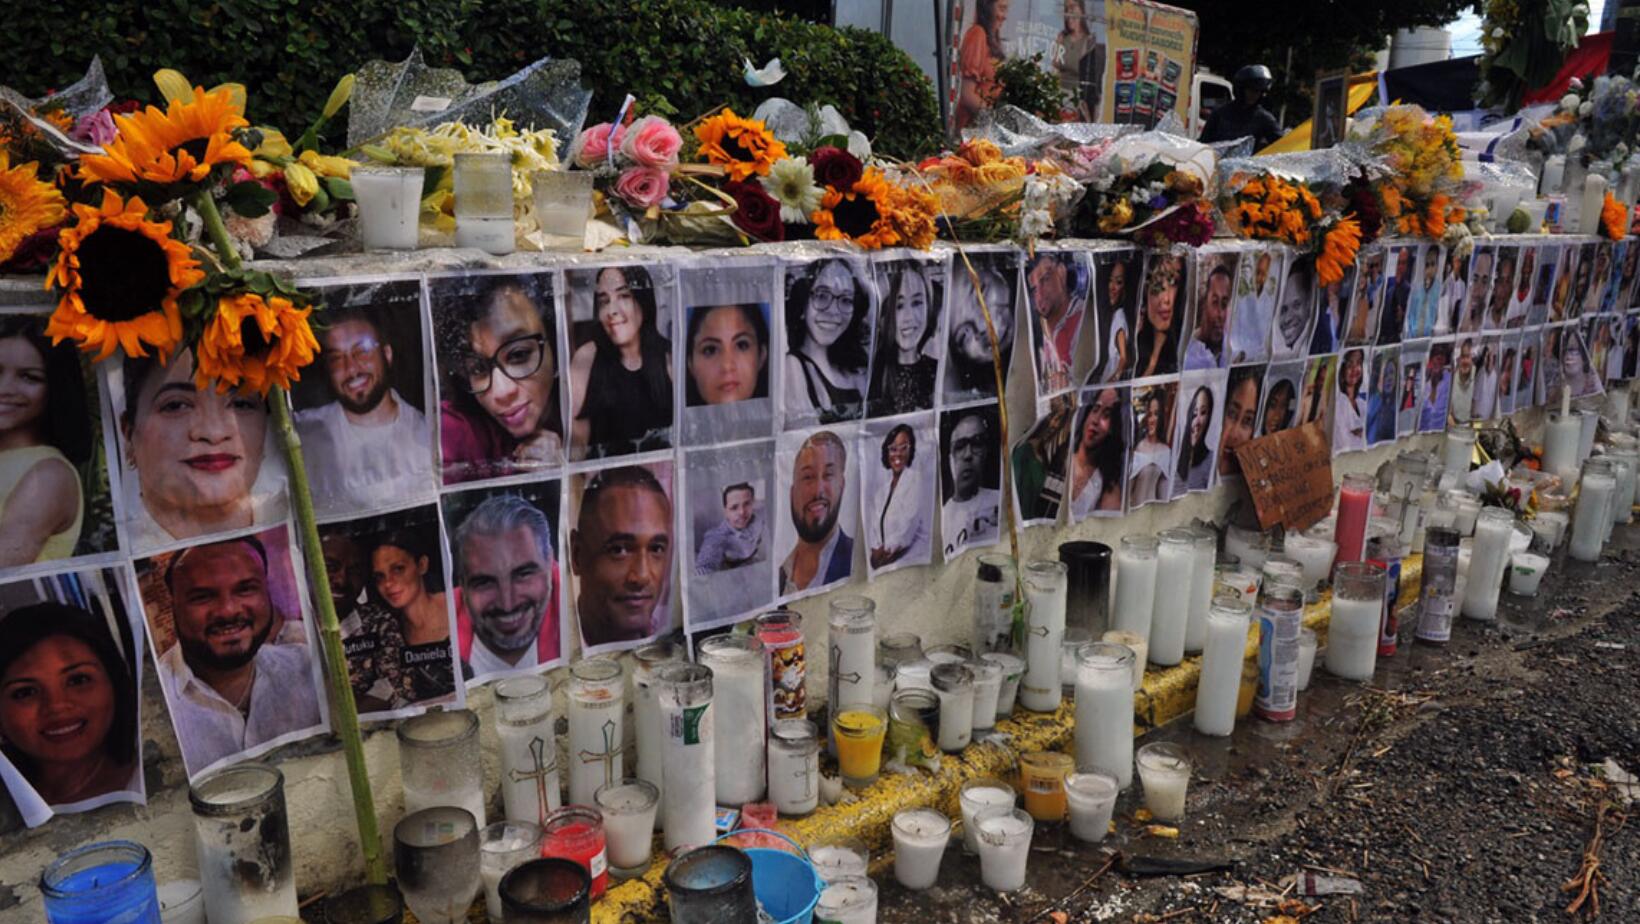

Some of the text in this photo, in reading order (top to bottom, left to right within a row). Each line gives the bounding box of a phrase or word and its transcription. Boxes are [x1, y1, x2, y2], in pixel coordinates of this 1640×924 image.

[1018, 35, 1065, 65] MEJOR
[345, 640, 375, 654] utuku
[405, 648, 446, 663] Daniela
